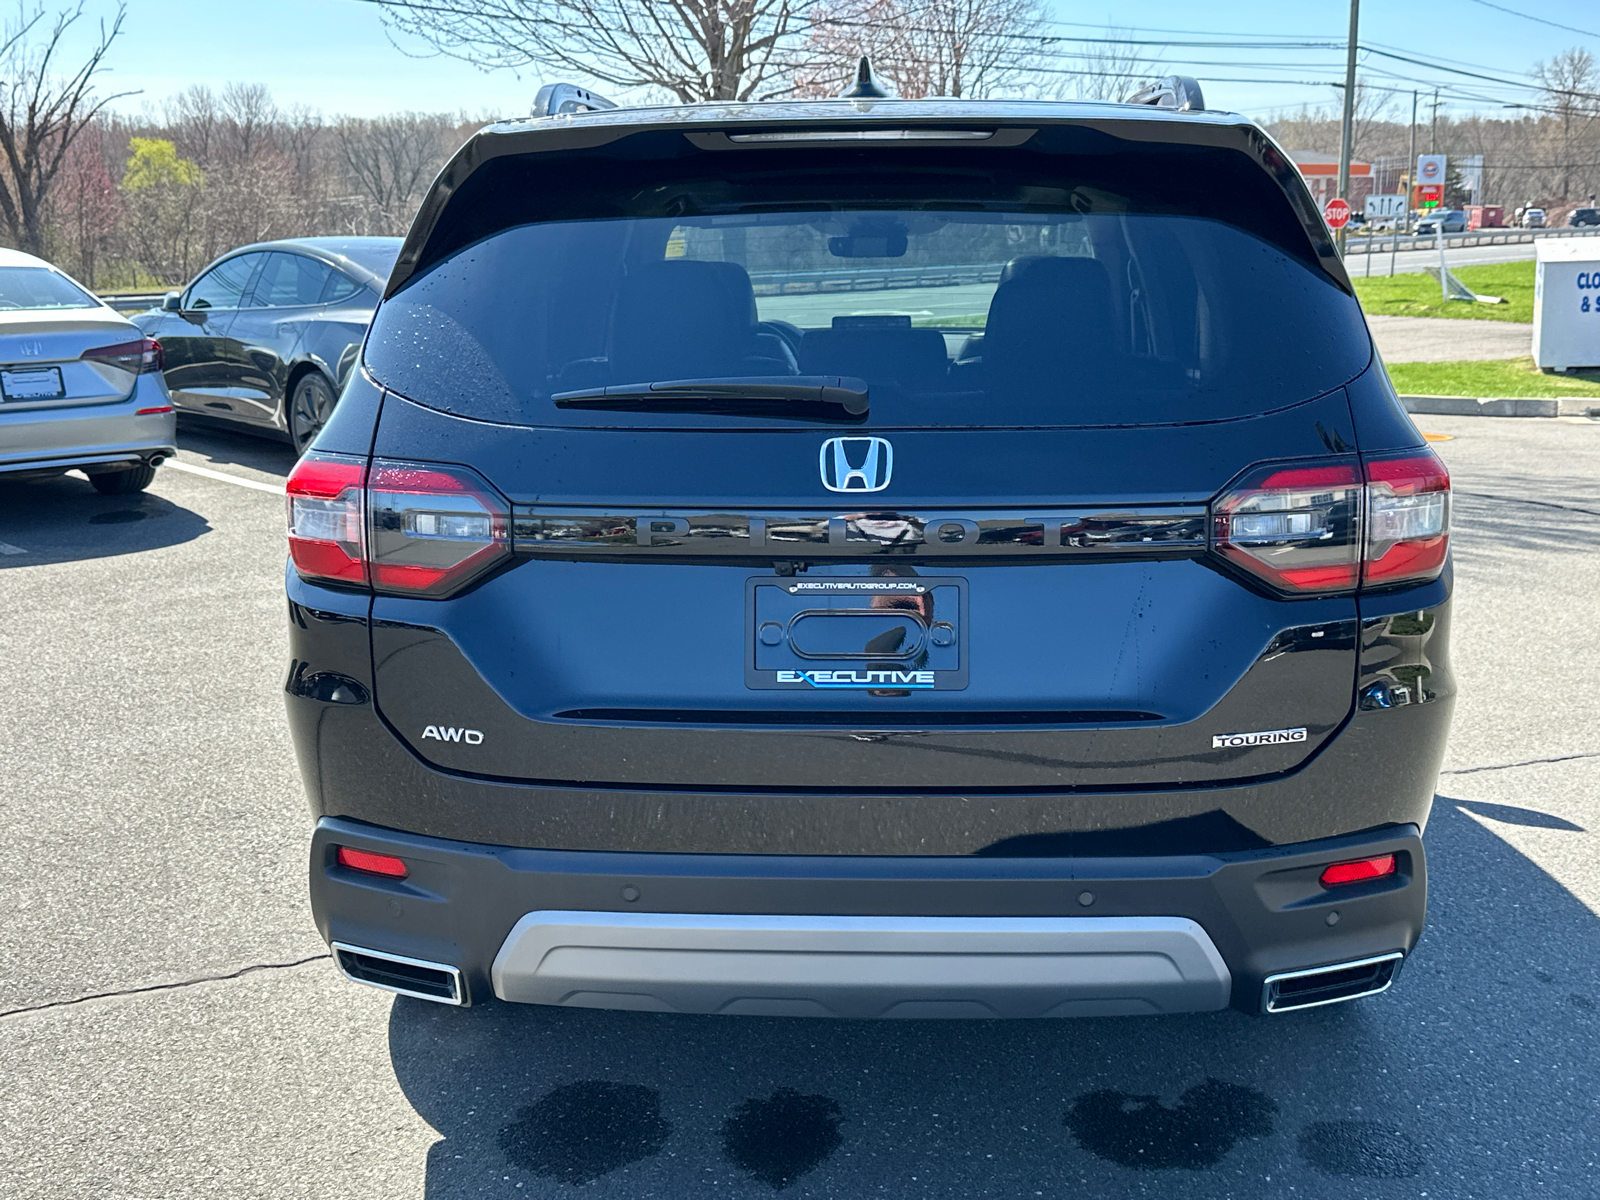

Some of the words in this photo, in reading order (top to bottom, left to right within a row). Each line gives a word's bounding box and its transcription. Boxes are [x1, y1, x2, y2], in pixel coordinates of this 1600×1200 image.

[1326, 207, 1349, 220] STOP
[1577, 272, 1600, 289] CLO
[1581, 296, 1591, 312] &
[636, 516, 1082, 547] PILOT
[797, 582, 917, 590] EXECUTIVEAUTOGROUP.COM
[776, 670, 935, 688] EXECUTIVE
[421, 725, 484, 745] AWD
[1217, 731, 1305, 747] TOURING
